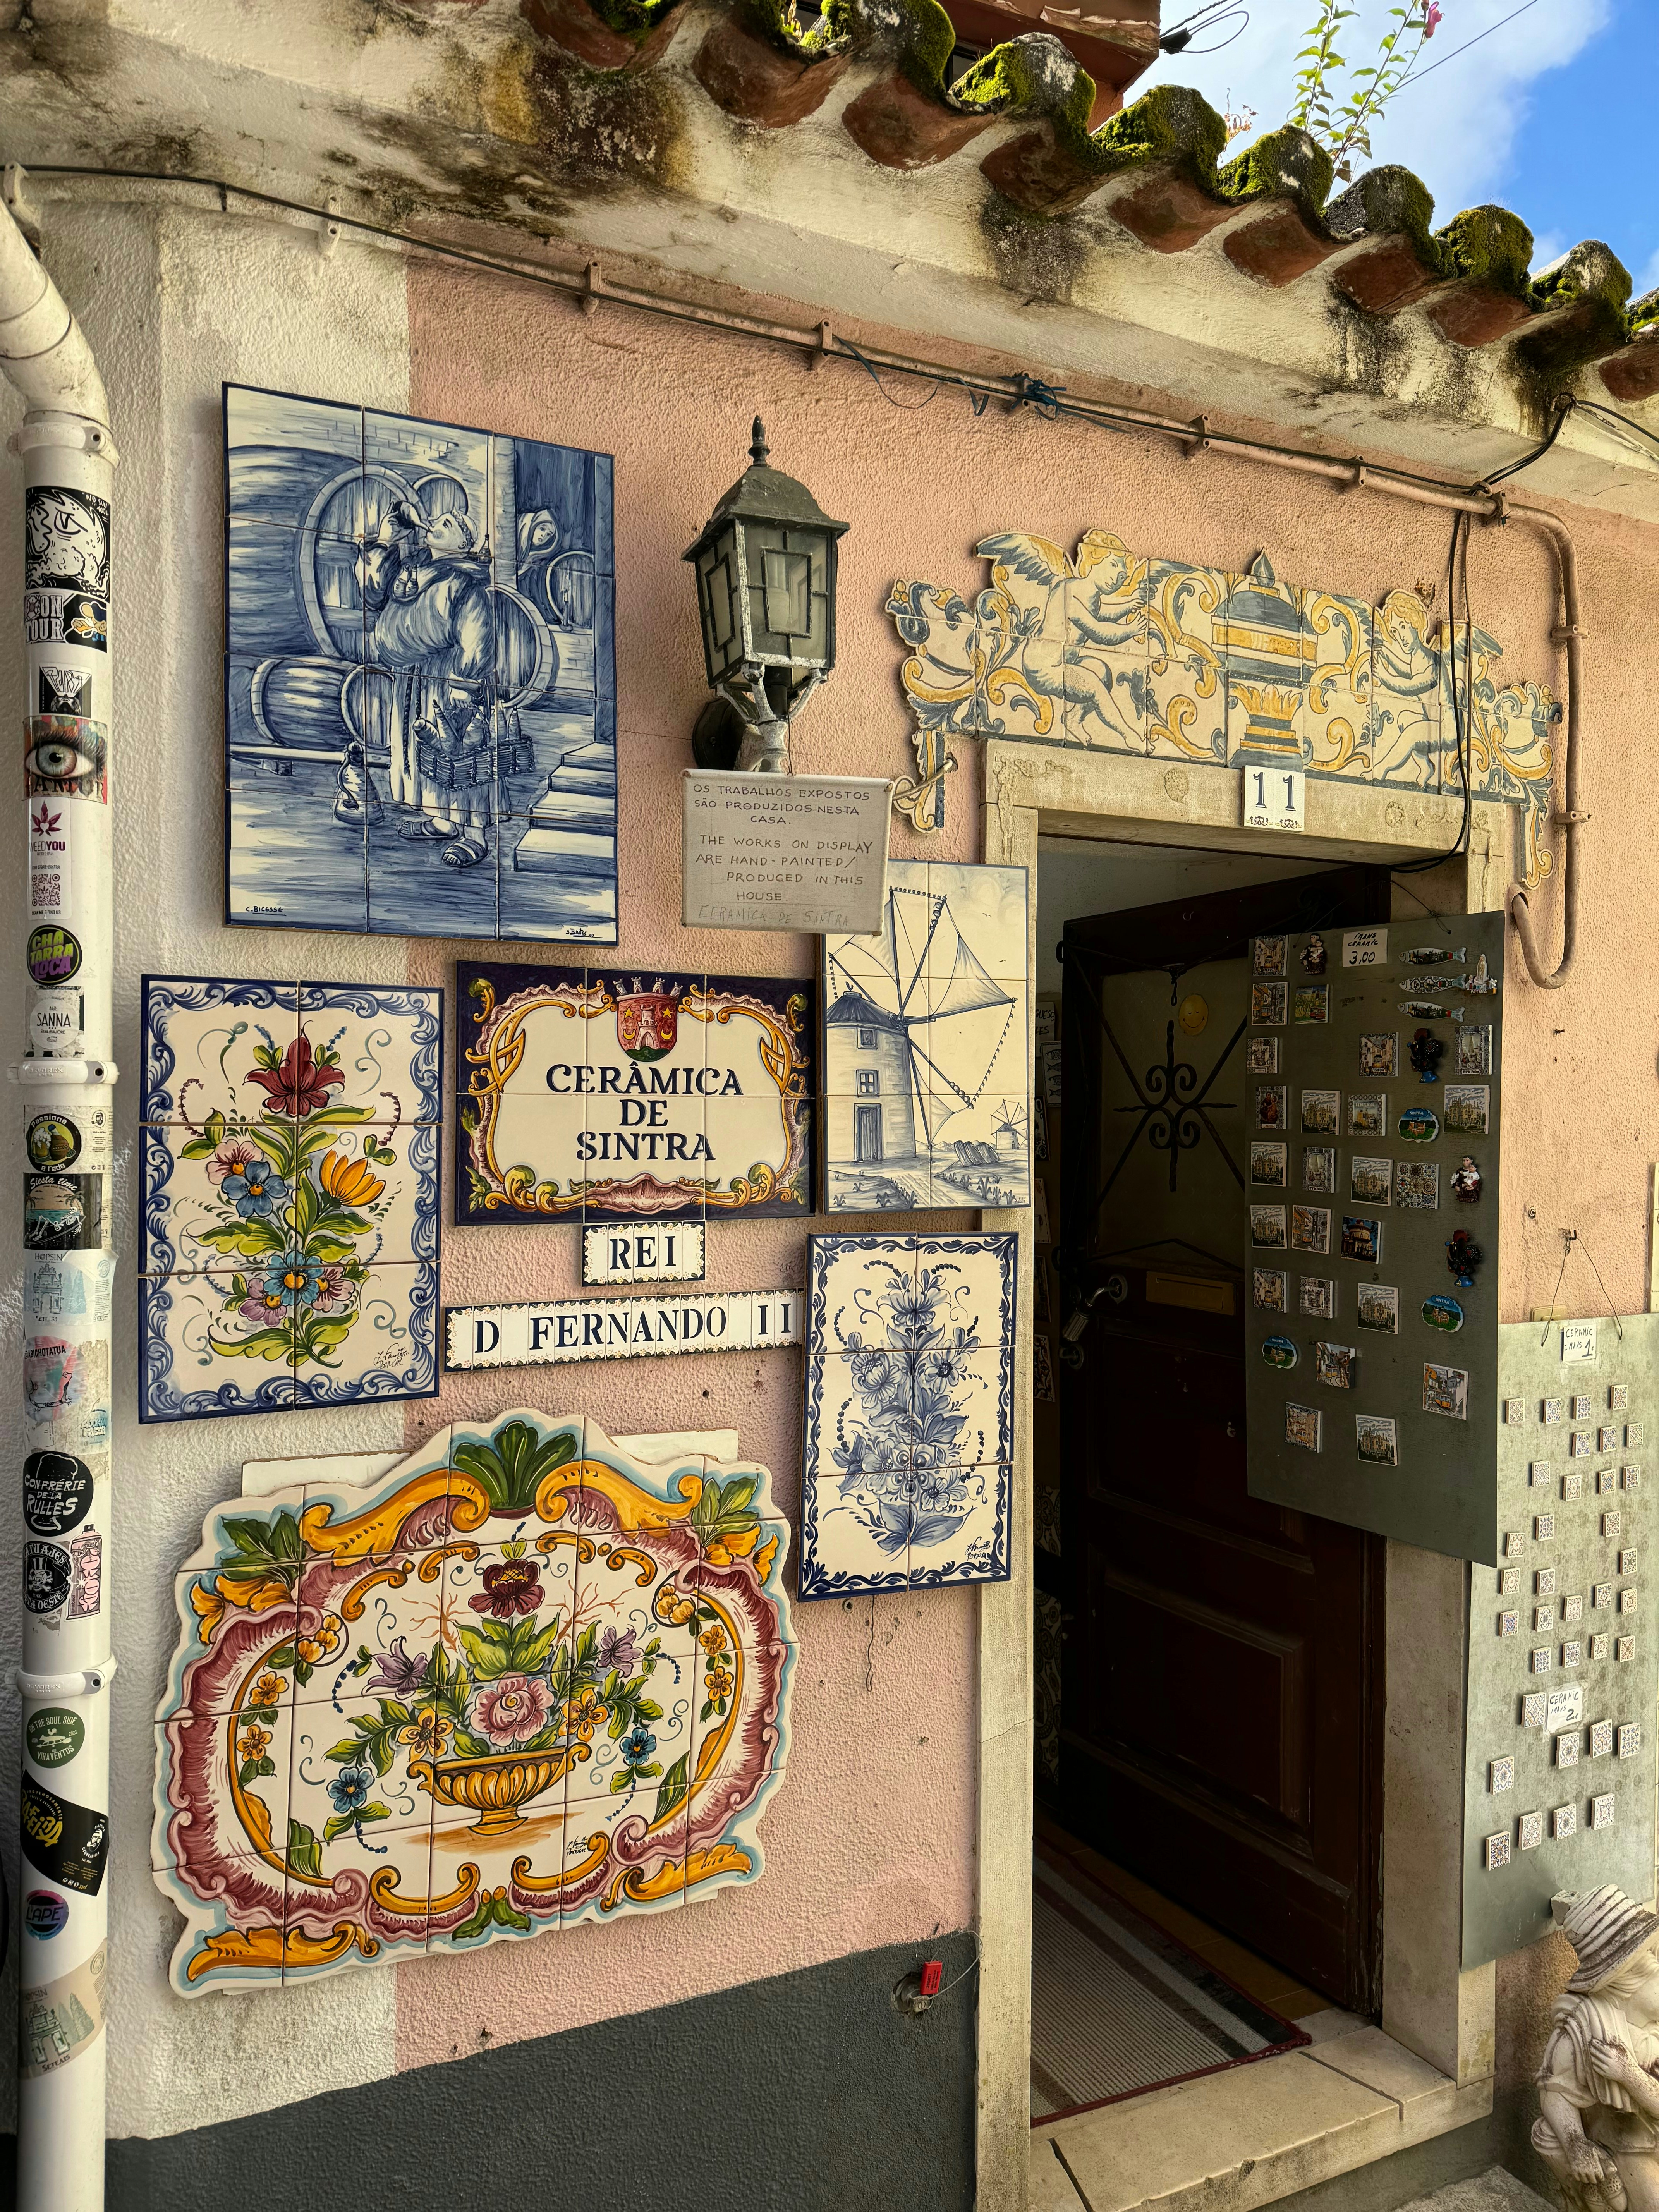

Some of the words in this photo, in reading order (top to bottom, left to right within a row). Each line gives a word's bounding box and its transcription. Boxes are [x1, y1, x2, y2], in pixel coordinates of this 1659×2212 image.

[41, 595, 62, 617] ON
[25, 618, 63, 642] TOUR
[693, 783, 709, 793] OS
[718, 785, 791, 797] TRABALHOS
[799, 790, 870, 800] EXPOSTOS
[1253, 771, 1296, 811] 11
[726, 802, 812, 812] PRODUZIDOS
[817, 806, 859, 815] NESTA
[751, 815, 791, 824] CASA.
[700, 835, 725, 845] THE
[734, 838, 781, 848] WORKS
[792, 840, 808, 848] ON
[817, 841, 872, 854] DISPLAY
[695, 854, 722, 865] ARE
[727, 872, 803, 883] PRODUCED
[816, 876, 828, 884] IN
[834, 875, 863, 885] THIS
[1349, 951, 1375, 965] 3,00
[37, 1013, 71, 1027] SANNA
[546, 1061, 744, 1096] CERÂMICA
[619, 1099, 669, 1127] DE
[576, 1131, 716, 1161] SINTRA
[30, 1176, 55, 1190] Siesta
[58, 1178, 77, 1190] time
[609, 1235, 677, 1270] REI
[474, 1319, 500, 1353] D
[529, 1305, 727, 1350] FERNANDO
[25, 1474, 86, 1491] CONFRÉRIE
[28, 1724, 36, 1733] ON
[36, 1719, 45, 1729] THE
[46, 1716, 61, 1725] SOUL
[63, 1716, 77, 1725] SIDE
[38, 1745, 74, 1761] VIRAVENTOS
[26, 1905, 63, 1922] L'APE
[41, 2054, 70, 2072] SETEAIS
